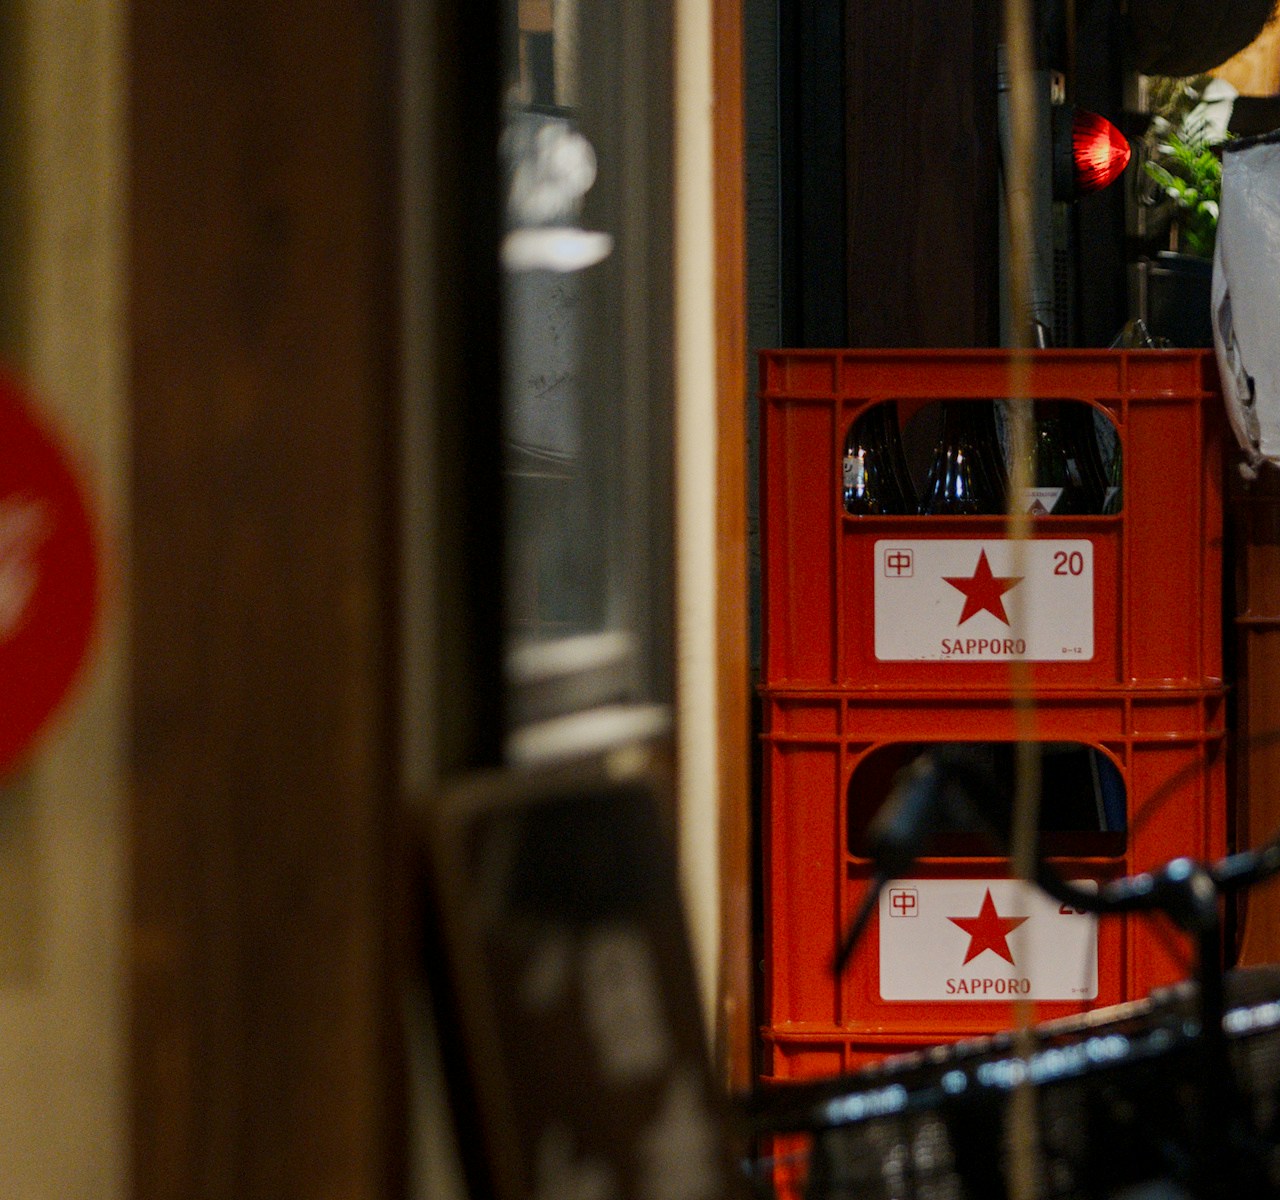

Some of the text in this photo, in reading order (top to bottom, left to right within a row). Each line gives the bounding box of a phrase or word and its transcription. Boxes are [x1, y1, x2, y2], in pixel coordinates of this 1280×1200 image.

[887, 551, 911, 575] 中
[1053, 551, 1084, 576] 20
[941, 638, 1027, 655] SAPPORO
[892, 891, 916, 915] 中
[946, 978, 1031, 994] SAPPORO
